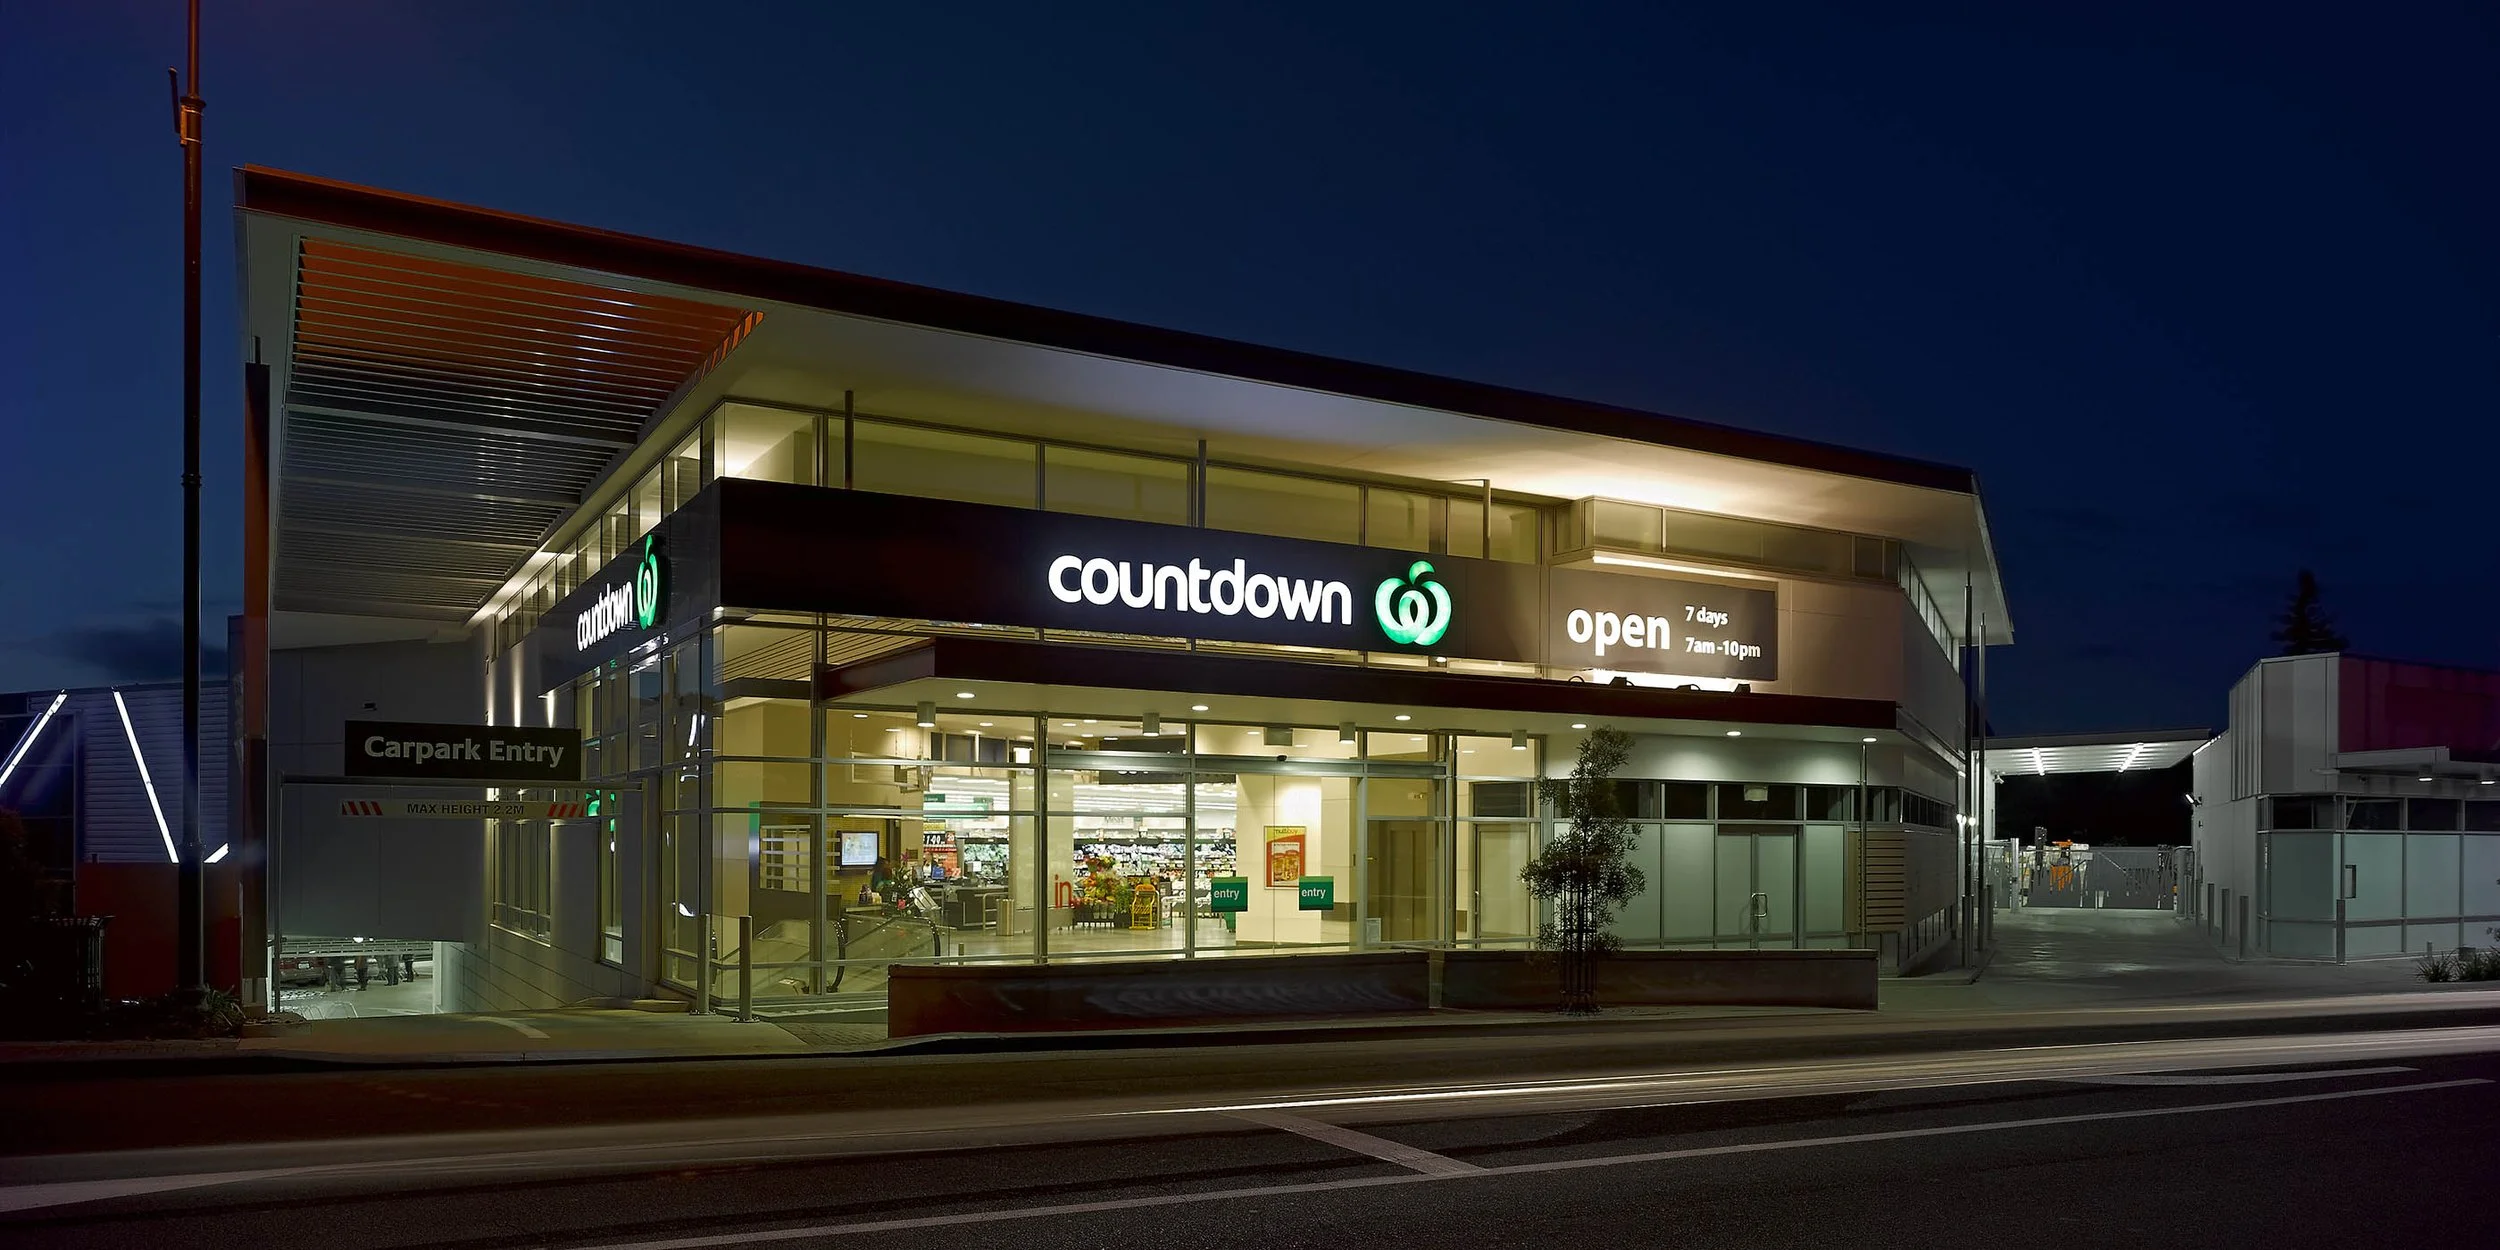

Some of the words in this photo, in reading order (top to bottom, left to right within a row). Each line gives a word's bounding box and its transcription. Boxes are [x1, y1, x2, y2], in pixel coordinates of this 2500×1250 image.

[1047, 554, 1353, 626] countdown
[576, 581, 633, 652] countdown
[1685, 605, 1695, 621] 7
[1696, 606, 1729, 628] days
[1566, 608, 1671, 657] open
[364, 735, 481, 765] Carpark
[489, 740, 564, 768] Entry
[406, 803, 439, 815] MAX
[441, 804, 489, 815] HEIGHT
[1213, 889, 1240, 900] entry
[1301, 888, 1326, 899] entry
